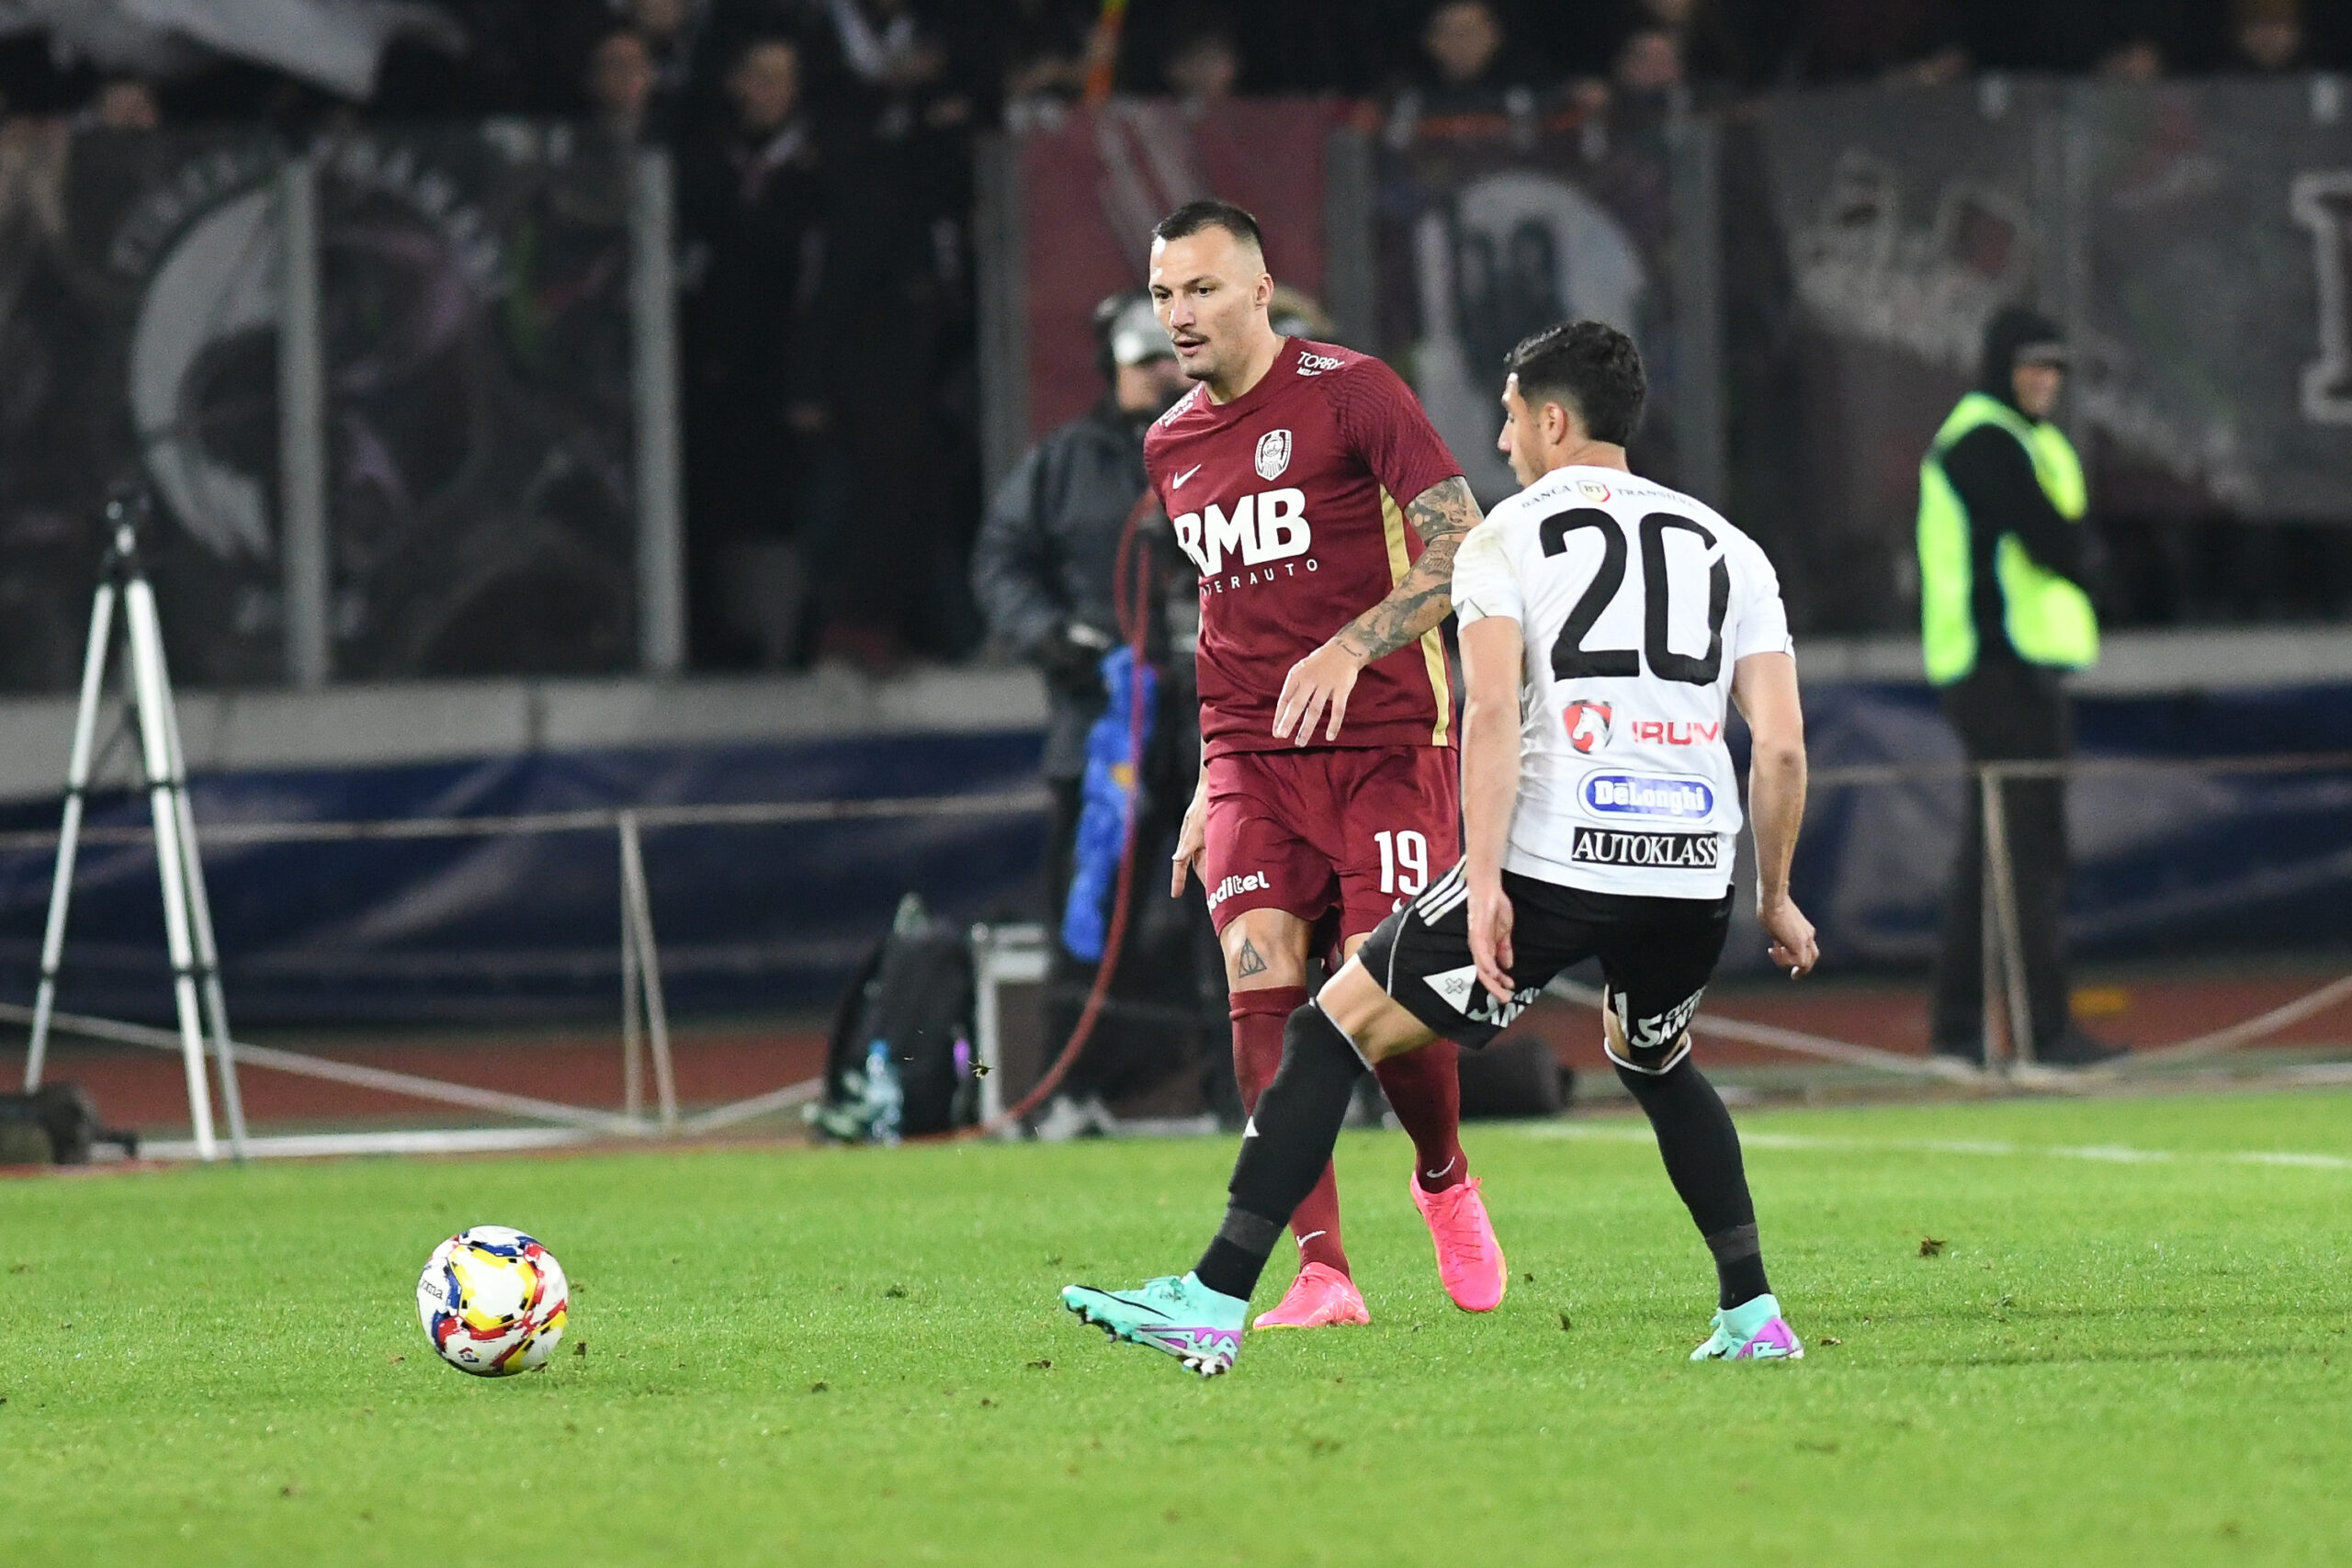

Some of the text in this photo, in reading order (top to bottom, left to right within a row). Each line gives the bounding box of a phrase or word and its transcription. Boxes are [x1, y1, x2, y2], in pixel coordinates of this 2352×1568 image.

[1296, 350, 1345, 370] TORRY
[1173, 488, 1311, 578] RMB
[1539, 507, 1731, 687] 20
[1374, 829, 1430, 897] 19
[1572, 830, 1718, 867] AUTOKLASS
[1206, 870, 1271, 918] editel
